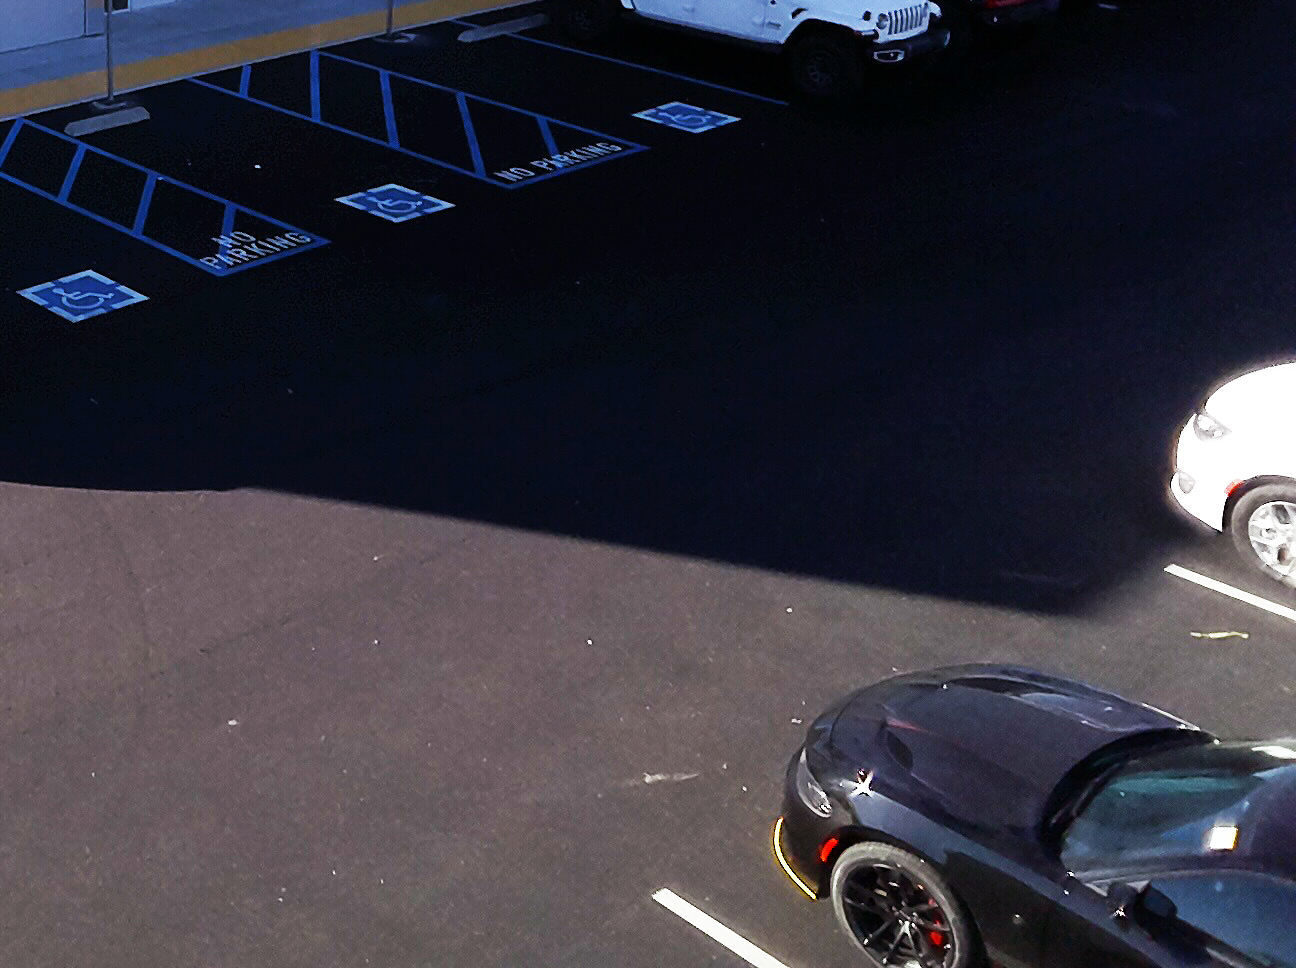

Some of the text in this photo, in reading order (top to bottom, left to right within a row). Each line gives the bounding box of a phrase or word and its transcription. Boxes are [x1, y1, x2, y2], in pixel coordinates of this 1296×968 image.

[493, 142, 622, 182] NO PARKING
[200, 232, 311, 270] PARKING
[211, 231, 256, 248] NO
